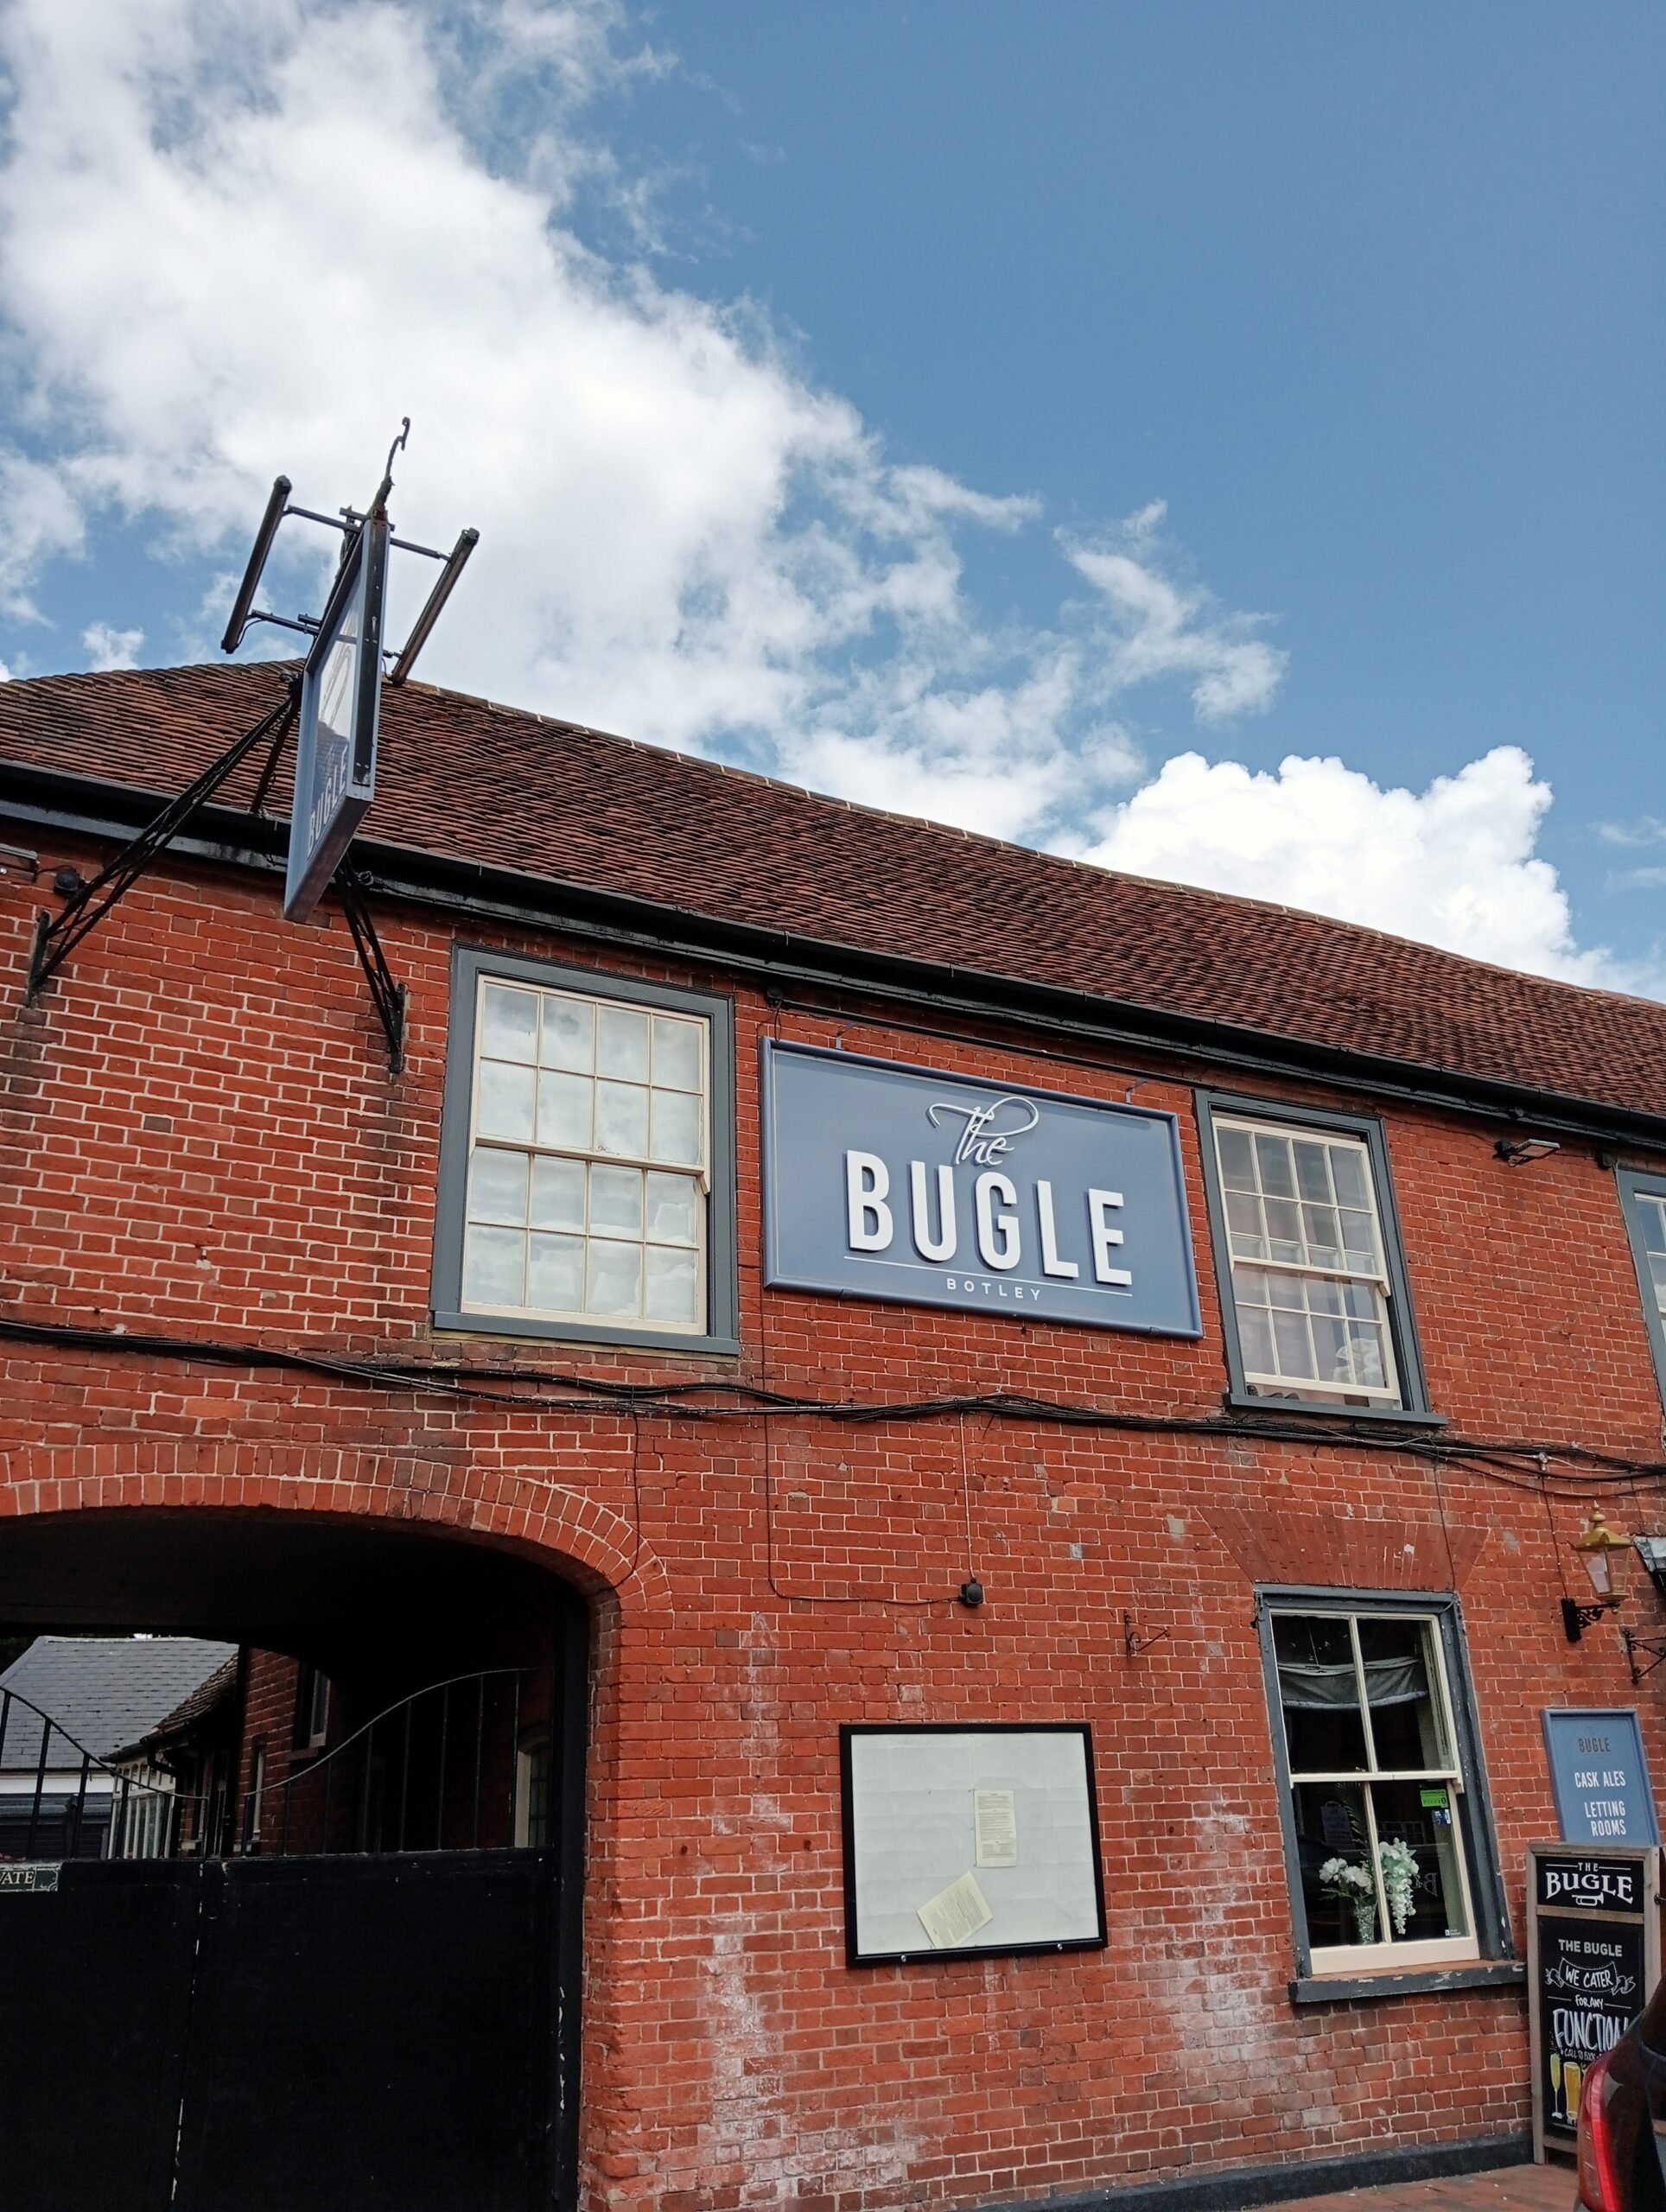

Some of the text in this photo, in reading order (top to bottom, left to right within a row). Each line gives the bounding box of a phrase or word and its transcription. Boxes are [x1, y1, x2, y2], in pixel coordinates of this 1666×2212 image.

[926, 1096, 1040, 1166] The
[845, 1149, 1133, 1286] BUGLE
[946, 1278, 1041, 1301] BOTLEY
[1578, 1737, 1612, 1753] BUGLE
[1574, 1770, 1626, 1788] CASK ALES
[1584, 1800, 1626, 1818] LETTING
[1590, 1819, 1626, 1837] ROOMS
[1578, 1862, 1599, 1872] THE
[1545, 1872, 1633, 1904] BUGLE
[1558, 1938, 1623, 1957] THE BUGLE
[1565, 1965, 1613, 1988] WE CATER
[1574, 1994, 1604, 2010] FOR ANY
